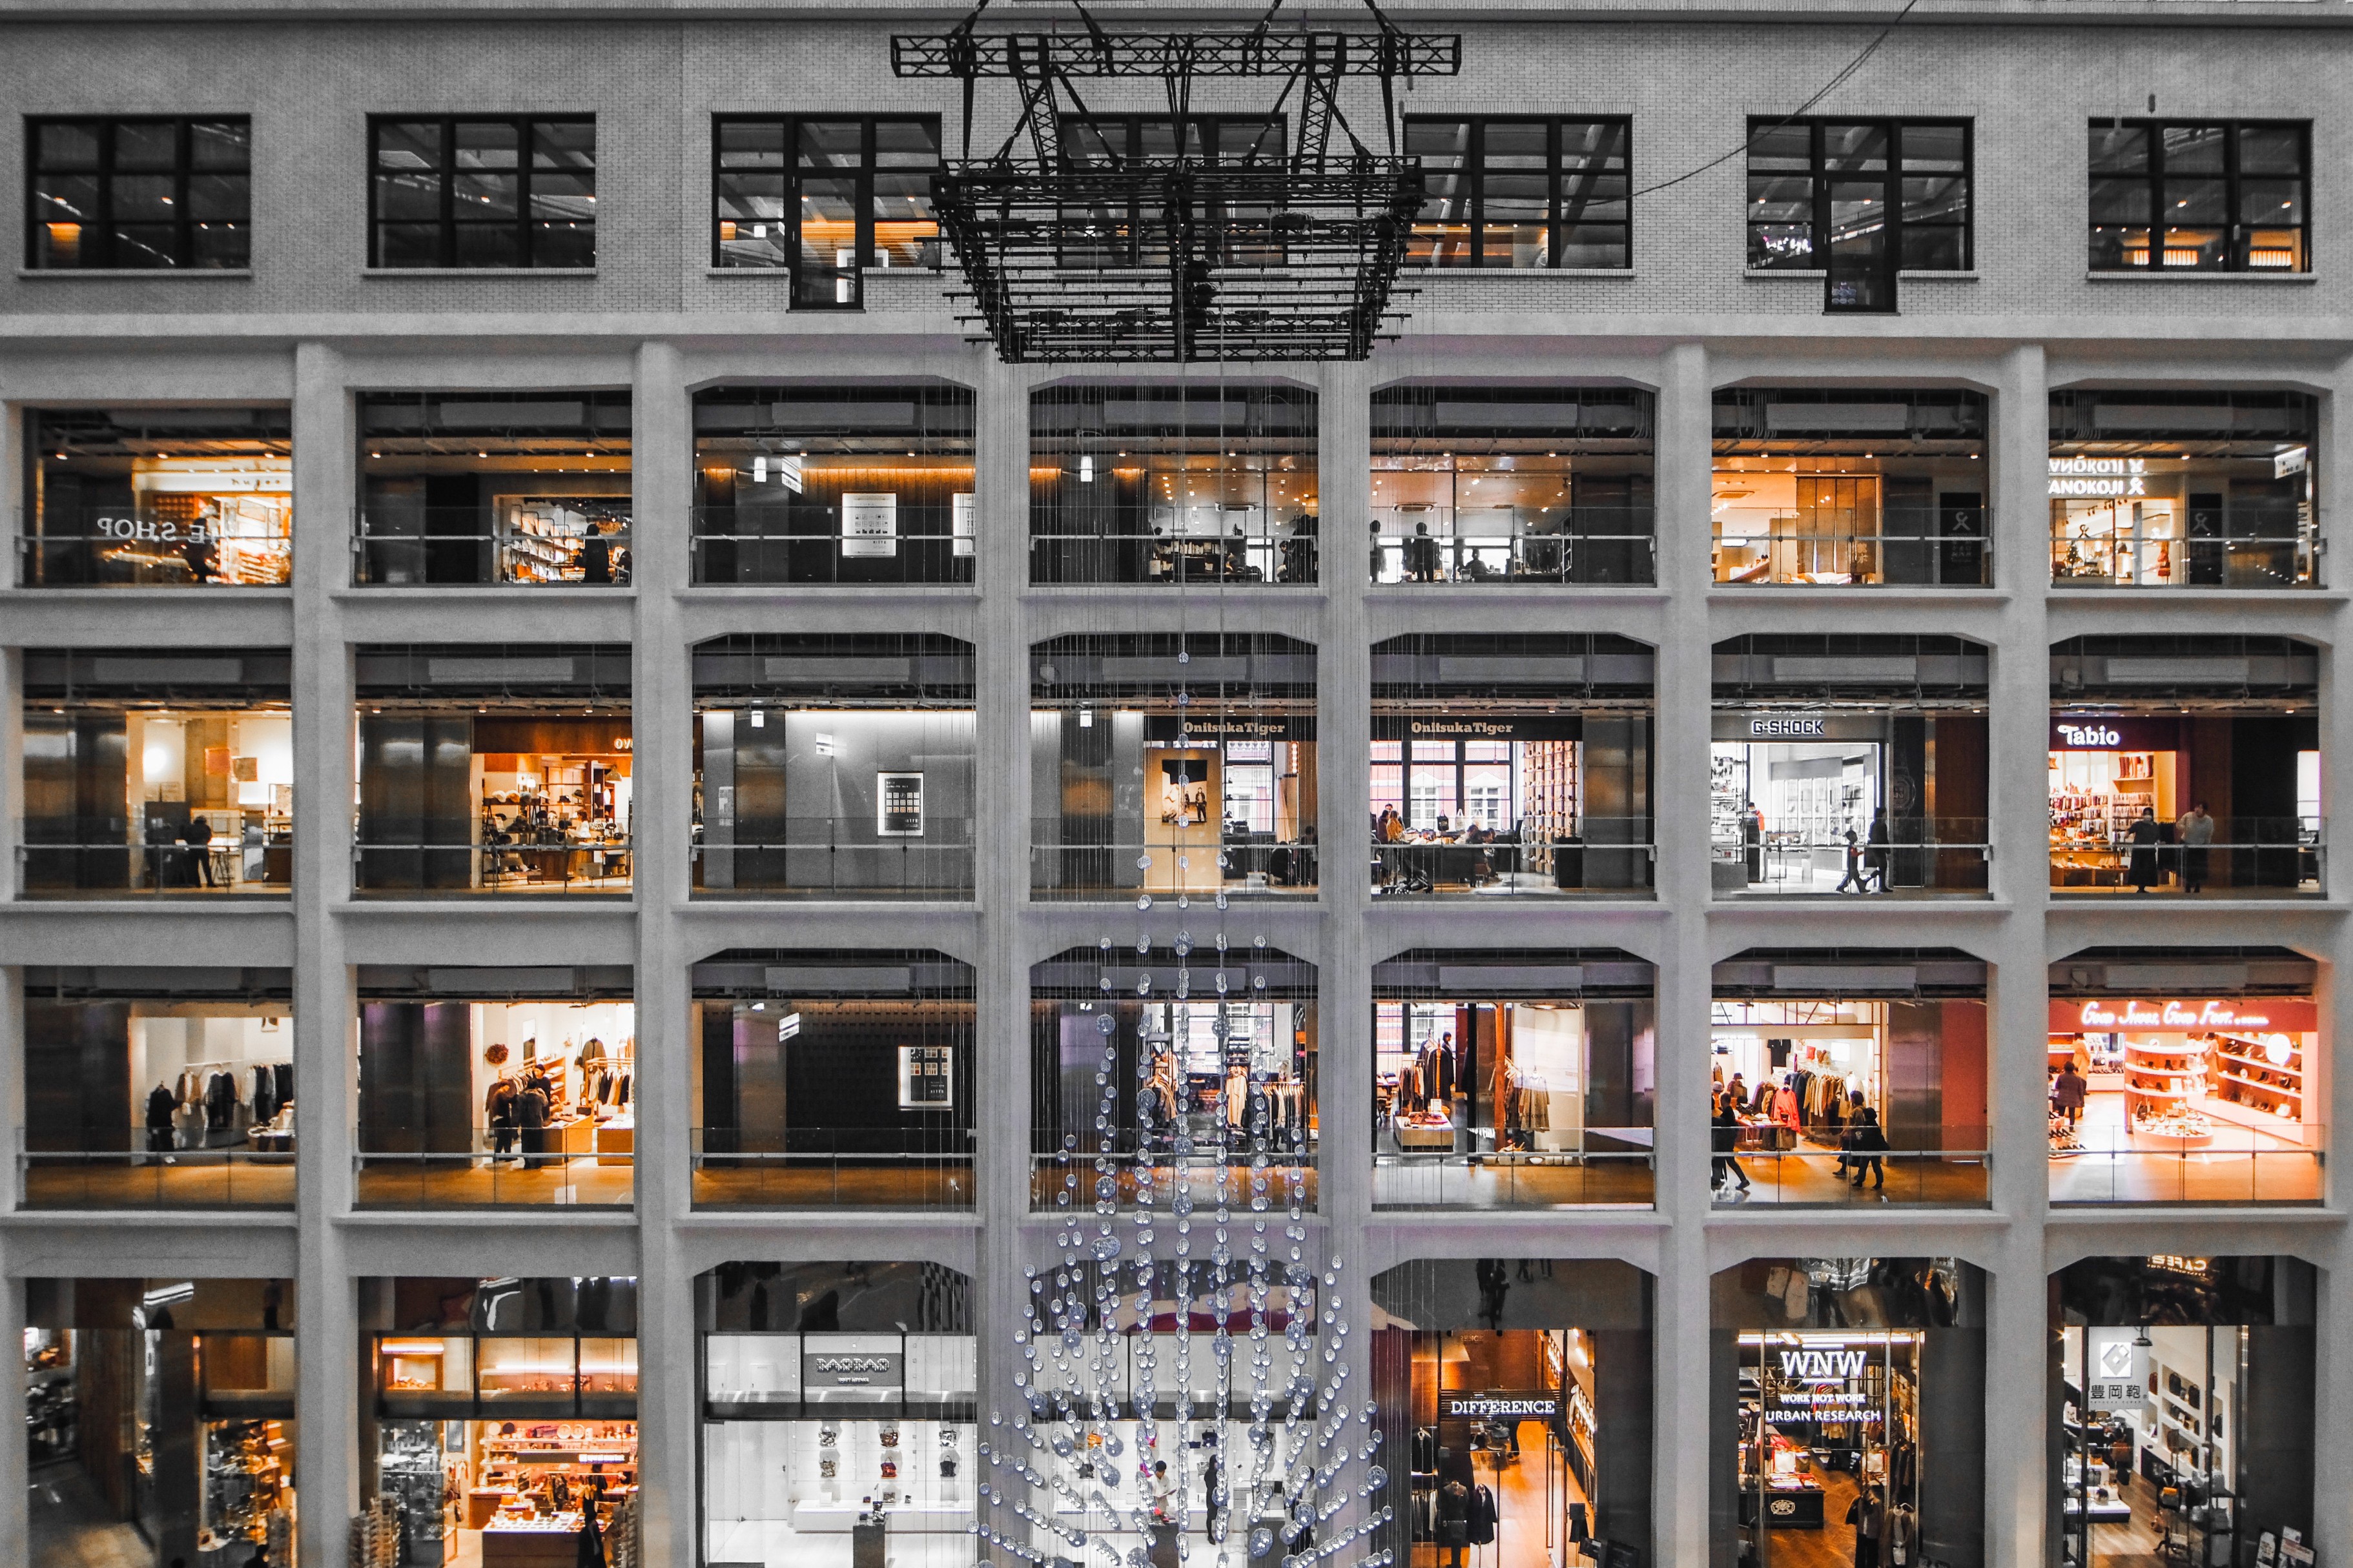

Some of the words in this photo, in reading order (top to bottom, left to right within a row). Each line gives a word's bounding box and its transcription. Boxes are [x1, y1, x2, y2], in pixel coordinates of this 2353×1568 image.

[1182, 722, 1244, 733] Onitsuka
[1244, 722, 1285, 735] Tiger
[1411, 722, 1472, 733] Onitsuka
[1472, 722, 1514, 735] Tiger
[1752, 720, 1824, 734] G-SHOCK
[2057, 724, 2121, 746] Tabio
[1780, 1350, 1867, 1377] WNW
[1780, 1394, 1811, 1404] WORK
[1812, 1394, 1834, 1403] NOT
[1836, 1394, 1866, 1404] WORK
[1450, 1400, 1556, 1415] DIFFERENCE
[1765, 1410, 1811, 1423] URBAN
[1814, 1410, 1882, 1423] RESEARCH
